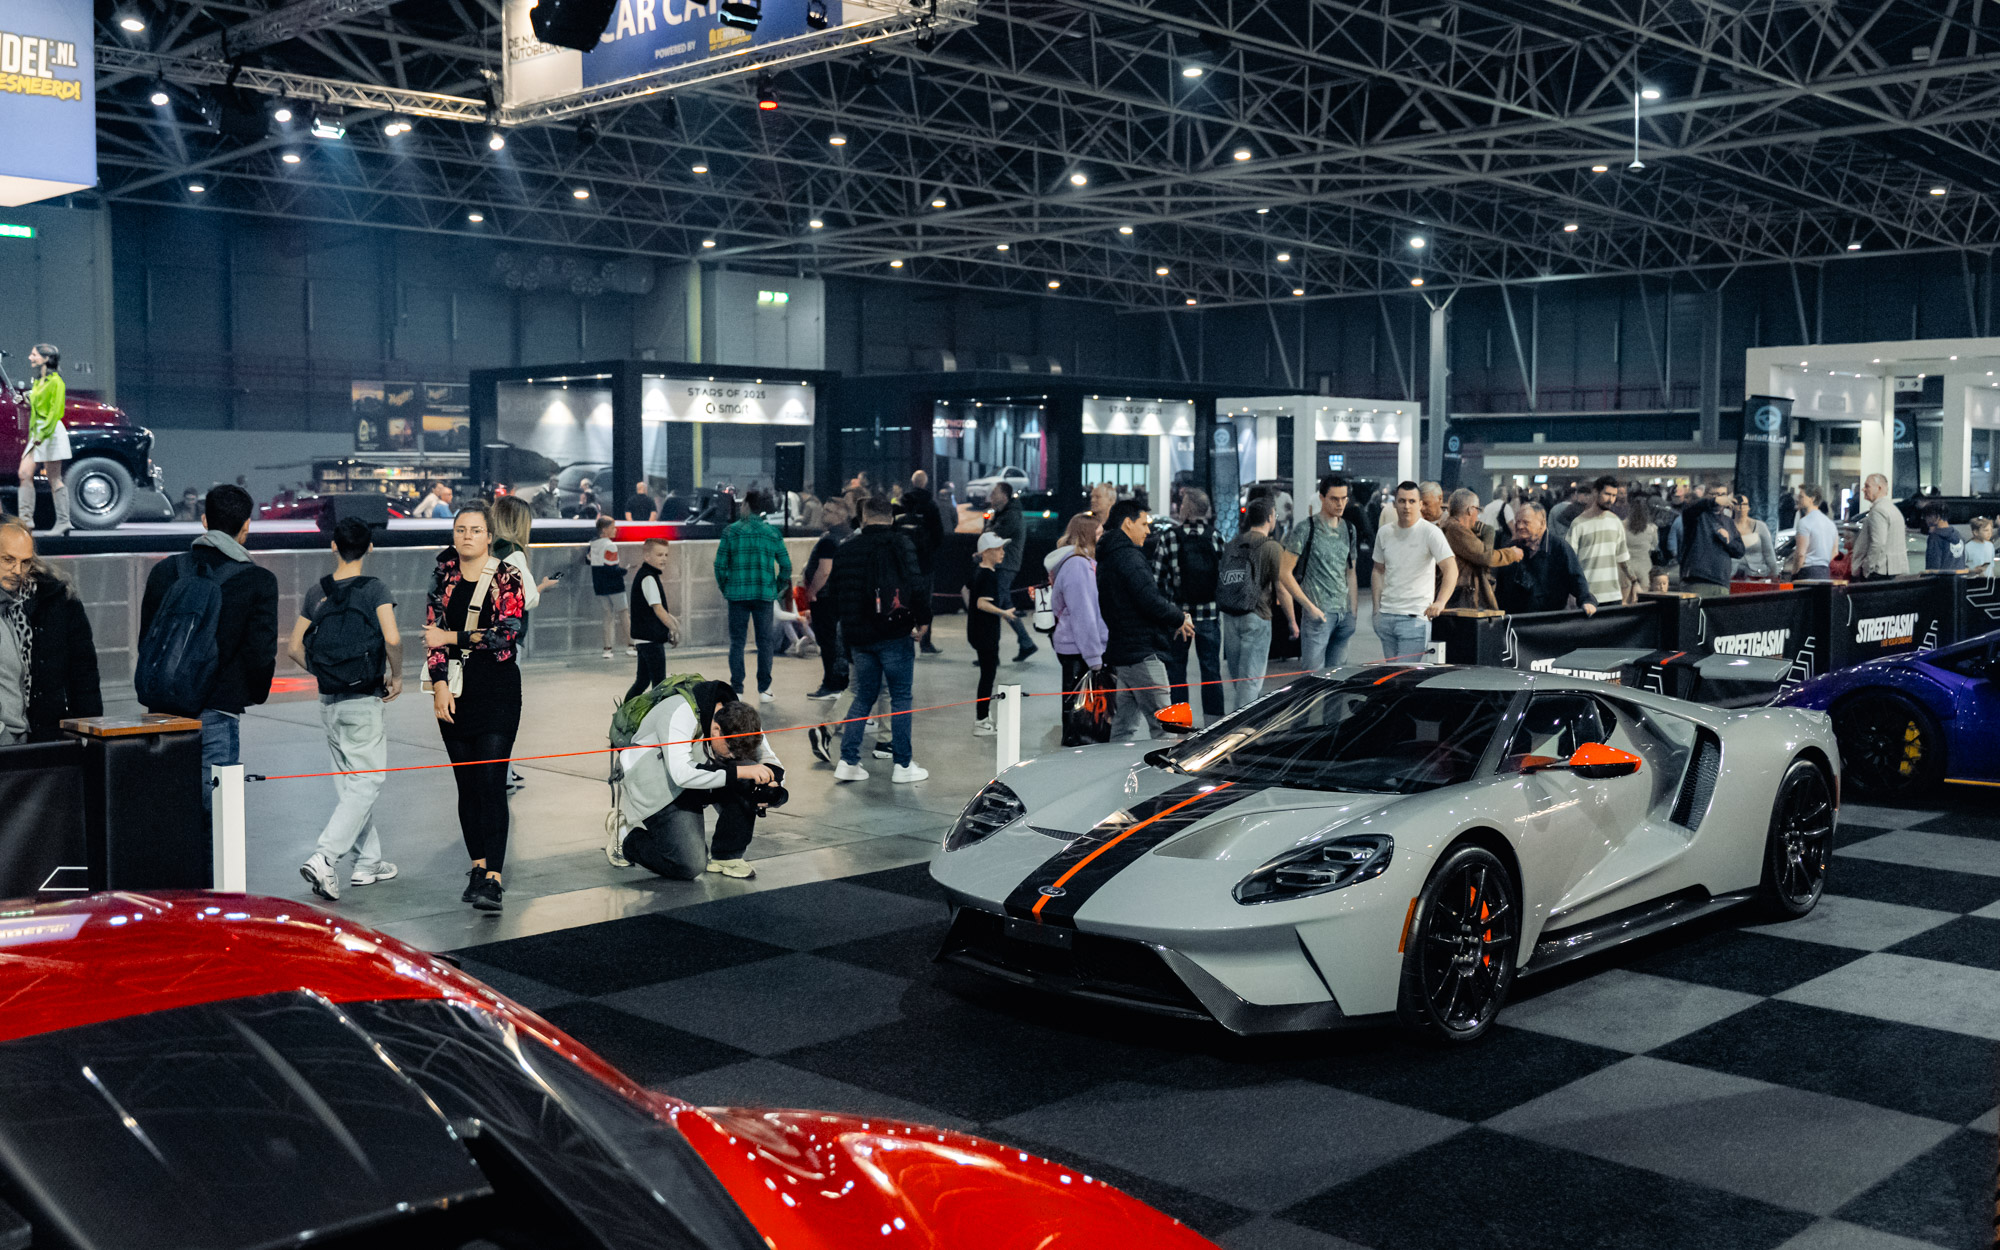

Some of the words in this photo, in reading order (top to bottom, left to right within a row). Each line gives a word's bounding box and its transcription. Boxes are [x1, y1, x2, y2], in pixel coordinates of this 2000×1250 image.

[600, 0, 657, 43] AR
[654, 42, 687, 59] POWERED
[687, 40, 696, 52] BY
[0, 72, 81, 101] ESMEERD!
[687, 387, 723, 398] STARS
[726, 388, 741, 398] OF
[743, 390, 766, 399] 2025
[718, 403, 749, 414] smart
[1539, 455, 1580, 468] FOOD
[1617, 454, 1678, 468] DRINKS
